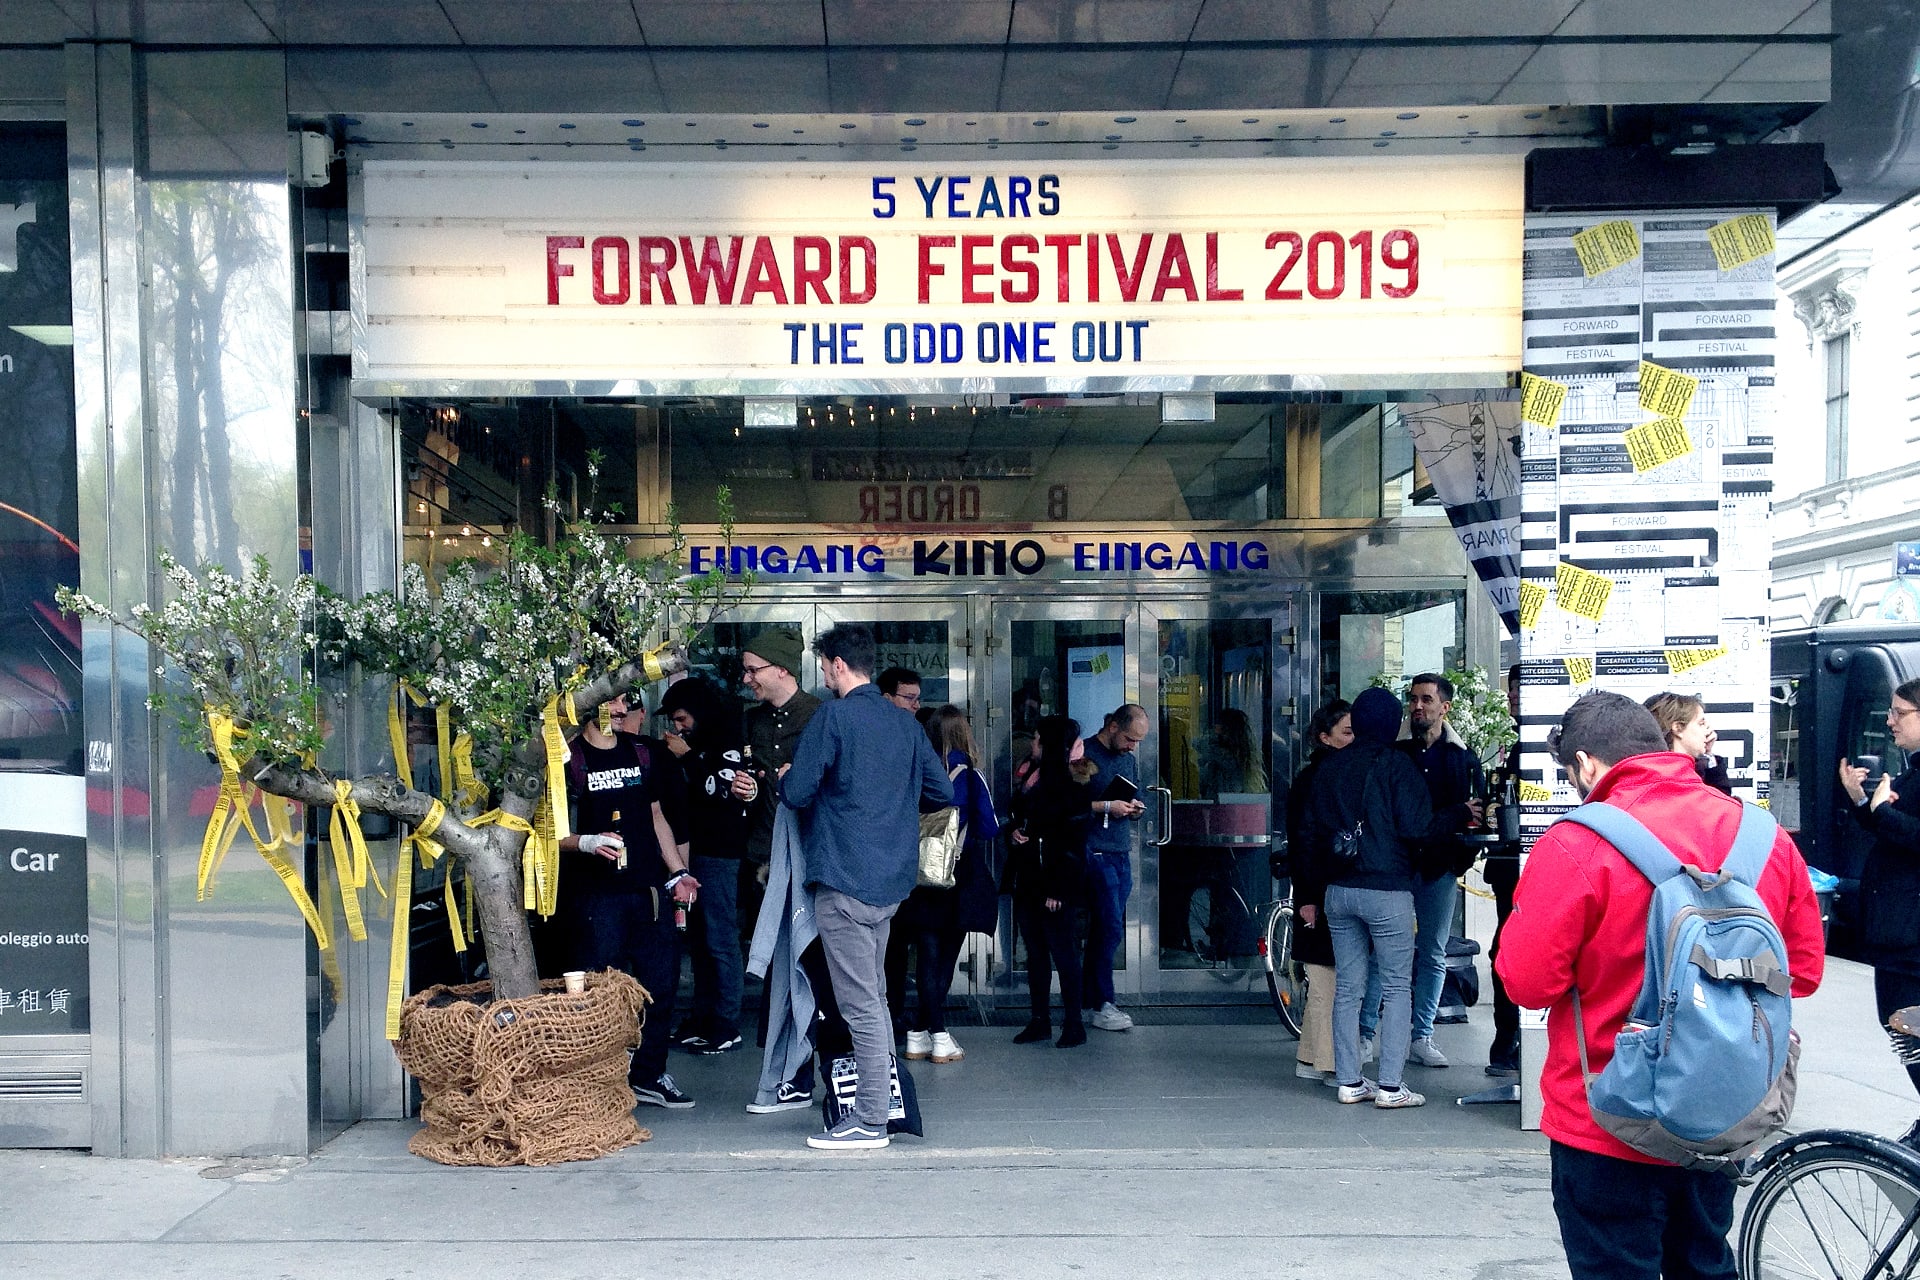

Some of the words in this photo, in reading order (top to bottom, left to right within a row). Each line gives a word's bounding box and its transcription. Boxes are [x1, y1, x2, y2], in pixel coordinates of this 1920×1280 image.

[873, 176, 896, 218] 5
[914, 174, 1060, 218] YEARS
[546, 235, 876, 305] FORWARD
[917, 231, 1244, 304] FESTIVAL
[1265, 229, 1419, 300] 2019
[1695, 314, 1751, 324] FORWARD
[1563, 320, 1619, 331] FORWARD
[783, 322, 863, 364] THE
[885, 322, 963, 364] ODD
[978, 321, 1056, 364] ONE
[1072, 319, 1149, 363] OUT
[1698, 343, 1748, 353] FESTIVAL
[1566, 349, 1616, 360] FESTIVAL
[1594, 424, 1626, 432] FORWARD
[1571, 465, 1622, 473] COMMUNICATION
[1612, 516, 1667, 526] FORWARD
[1615, 545, 1664, 554] FESTIVAL
[690, 544, 885, 574] EINGANG
[914, 540, 1046, 576] KINO
[1074, 541, 1269, 571] EINGANG
[588, 767, 641, 782] MONTANA
[588, 778, 624, 791] CANS
[10, 847, 59, 872] Car
[56, 933, 89, 944] auto
